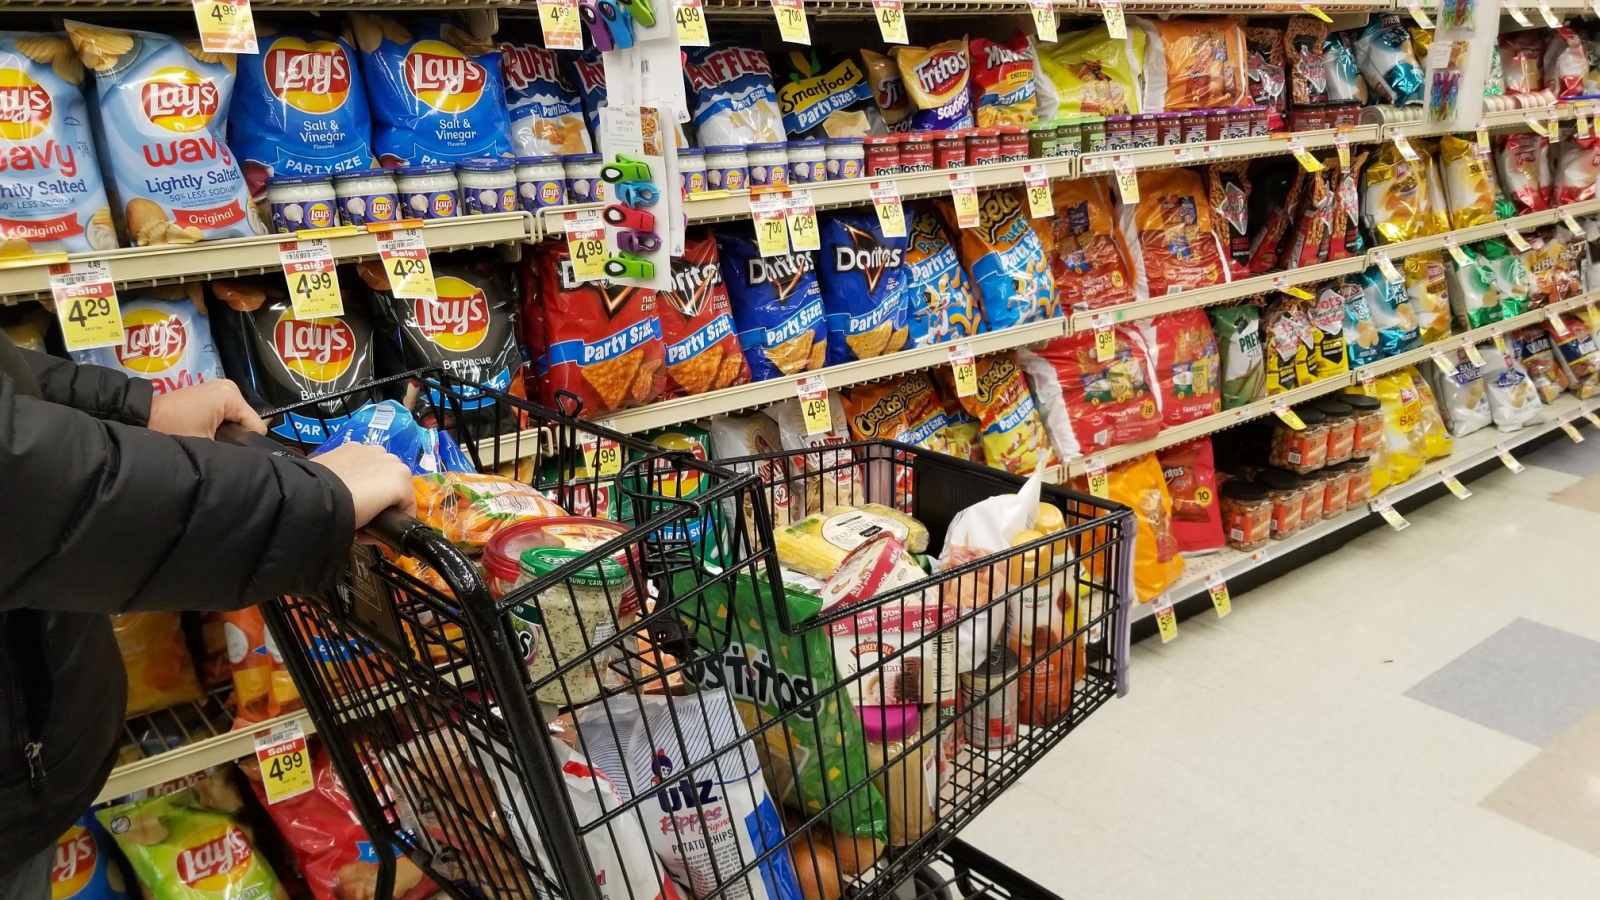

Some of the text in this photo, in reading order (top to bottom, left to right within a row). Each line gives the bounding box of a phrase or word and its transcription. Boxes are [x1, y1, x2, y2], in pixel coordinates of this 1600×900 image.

[274, 51, 346, 94] Lay's
[415, 54, 480, 95] Lay's
[913, 50, 967, 94] Fritos
[150, 82, 215, 118] Lay's
[781, 66, 855, 115] Smartfood
[0, 84, 47, 124] ay's
[797, 102, 832, 129] Party
[831, 89, 858, 109] Size!
[937, 90, 969, 121] SCOOPS!
[303, 119, 340, 132] Salt &
[435, 129, 477, 143] Vinegar
[439, 118, 472, 131] Salt &
[299, 131, 346, 145] Vinegar
[142, 134, 232, 168] wavy
[285, 155, 363, 175] PARTY SIZE
[40, 178, 87, 196] Salted
[145, 165, 241, 196] Lightly Salted
[17, 198, 39, 209] LESS
[170, 184, 236, 202] 50% LESS SODIUM
[188, 206, 235, 227] Original
[16, 221, 68, 239] Original
[574, 231, 598, 239] Sale!
[390, 250, 418, 258] Sale!
[836, 246, 902, 272] Doritos
[294, 262, 324, 272] Sale!
[749, 251, 815, 285] Doritos
[912, 254, 943, 281] Party
[66, 285, 102, 297] Sale!
[422, 294, 482, 336] Lay's
[766, 302, 822, 346] Party Size!
[850, 310, 883, 332] Party
[121, 313, 181, 360] Lay's
[284, 320, 348, 365] Lay's
[584, 334, 628, 363] Party
[668, 316, 731, 363] Party Size!
[442, 356, 492, 371] Barbecue
[976, 357, 1016, 404] Cheetos
[855, 395, 902, 436] Cheetos
[1197, 491, 1210, 500] 10
[889, 546, 899, 564] REAL
[832, 622, 848, 633] EAL
[857, 614, 875, 626] NEW
[881, 643, 894, 655] ILL
[267, 741, 297, 756] Sale!
[185, 828, 250, 883] Lay's
